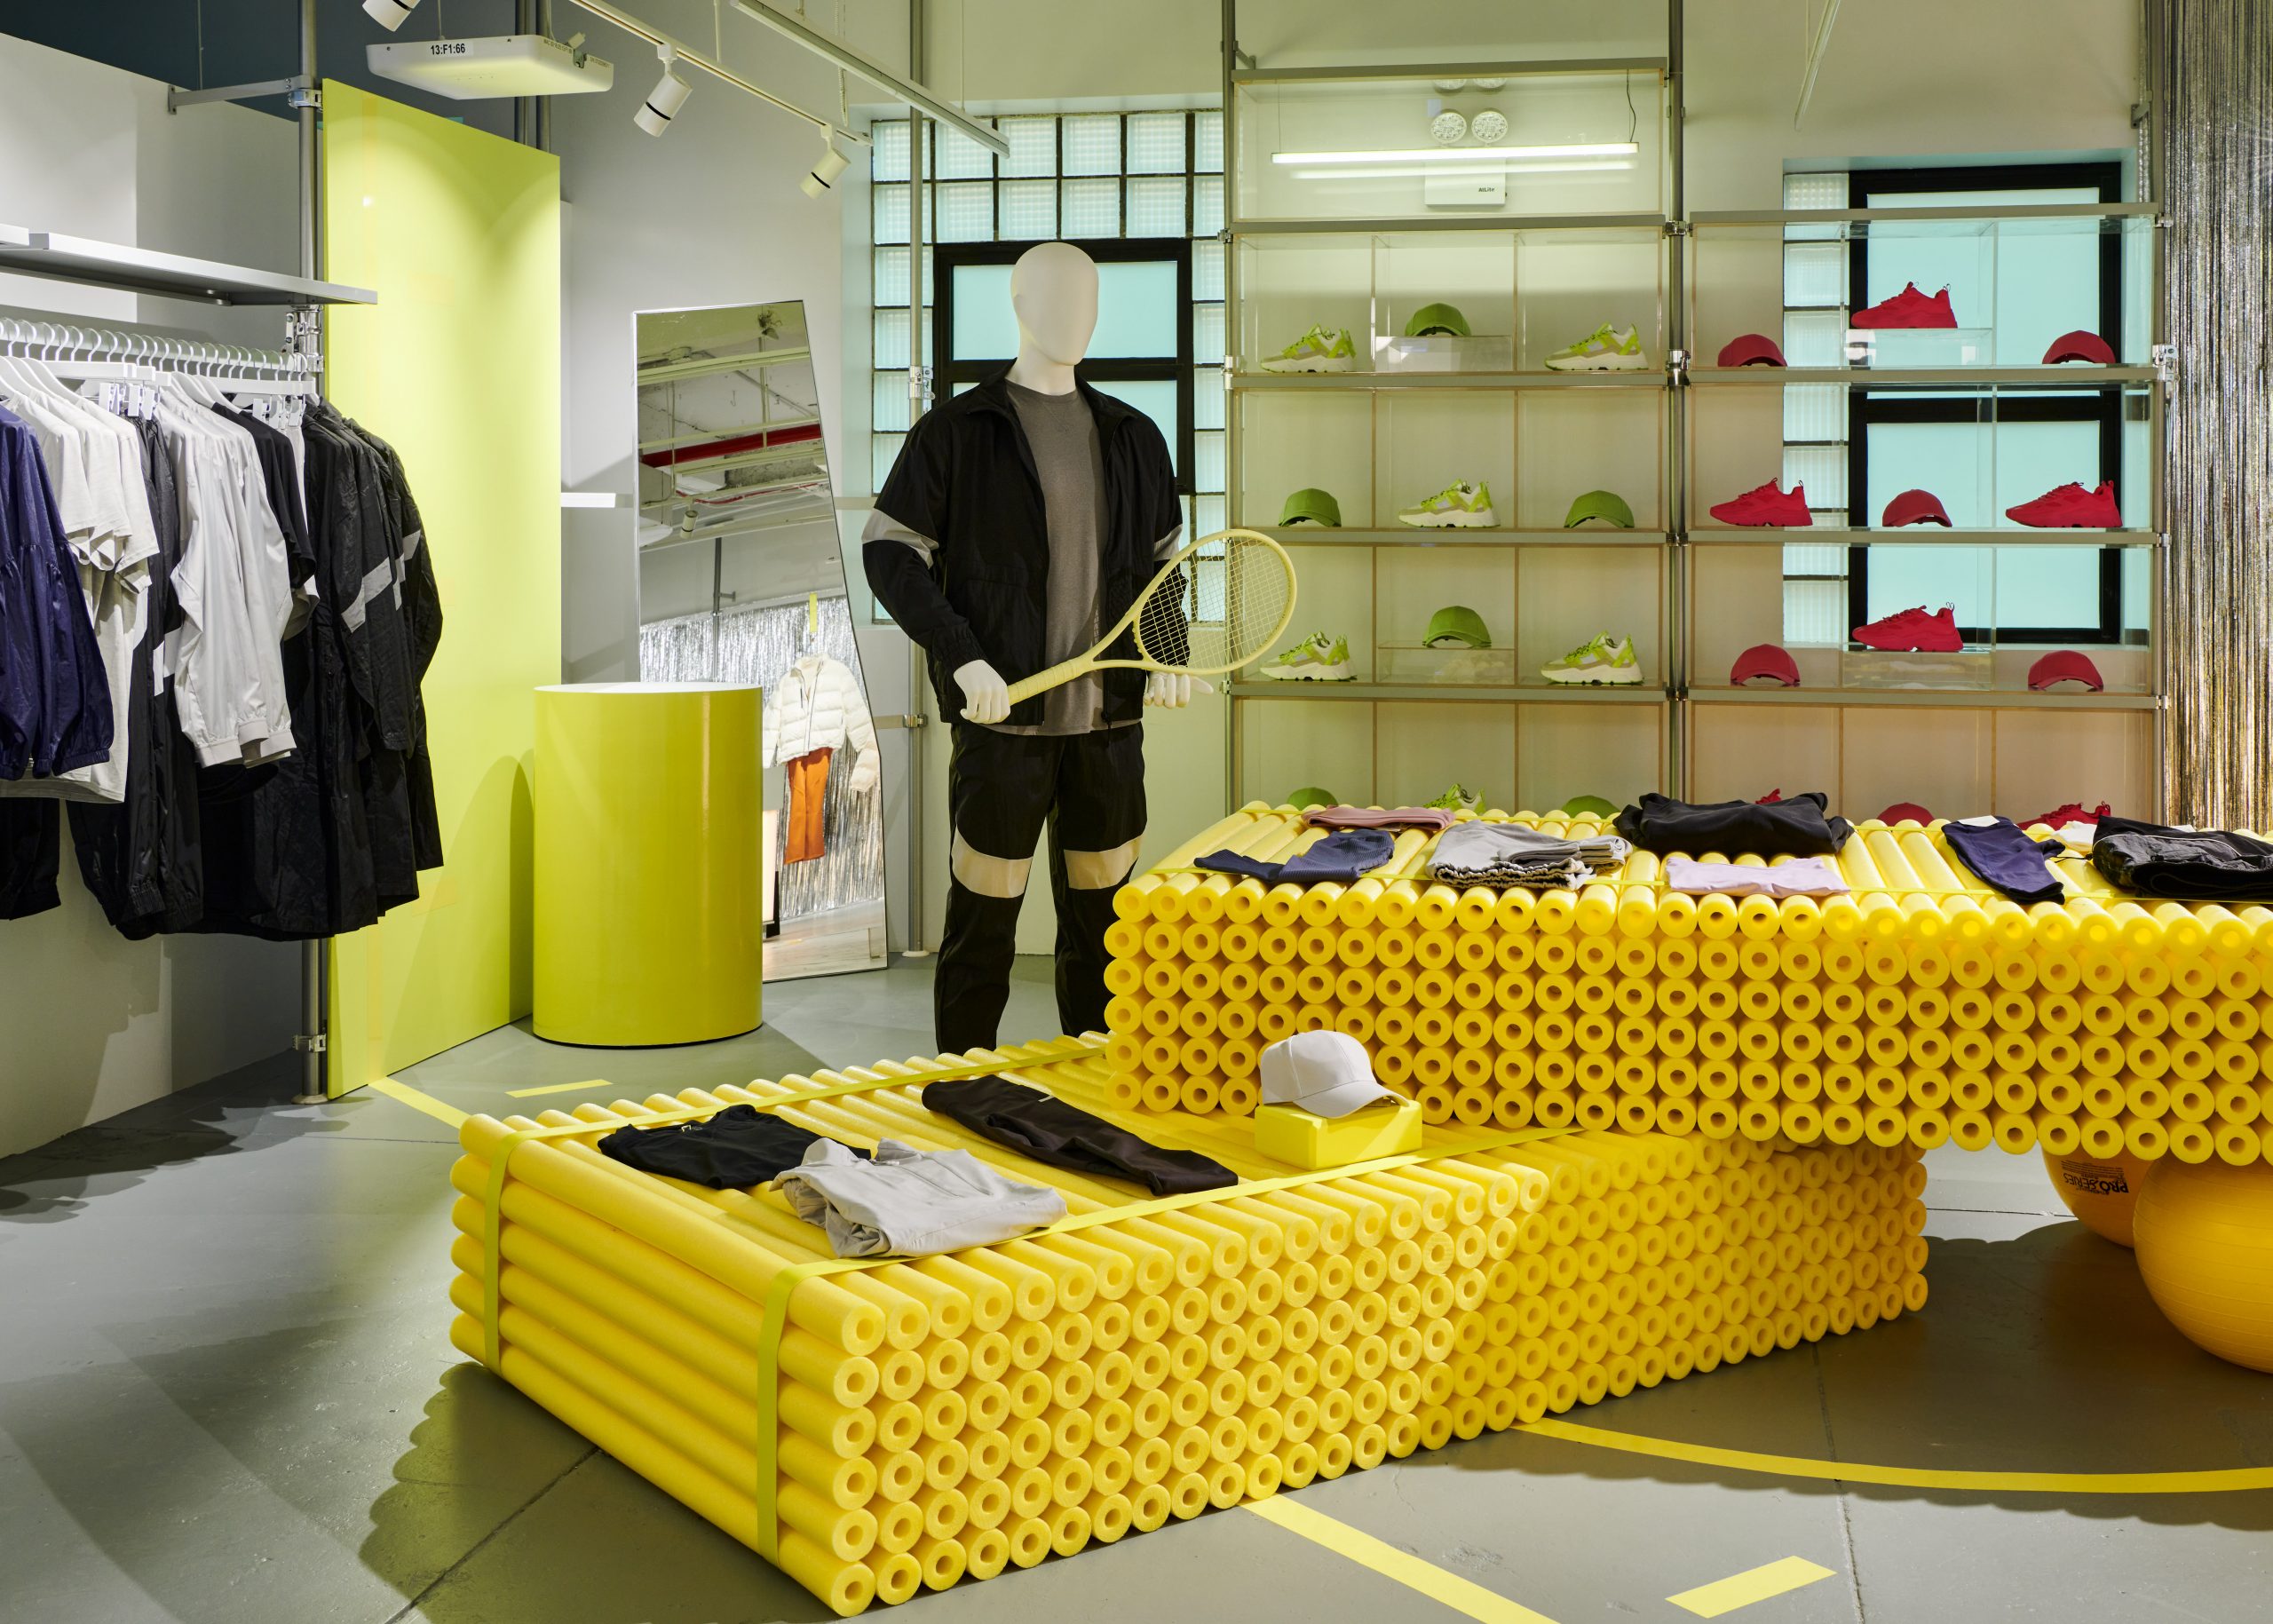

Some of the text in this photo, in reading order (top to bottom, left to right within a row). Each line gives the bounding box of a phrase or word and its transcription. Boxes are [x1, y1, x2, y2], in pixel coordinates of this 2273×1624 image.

[431, 44, 465, 55] 13:F1:66
[2063, 1173, 2097, 1190] SERIES
[2099, 1180, 2129, 1193] PRO
